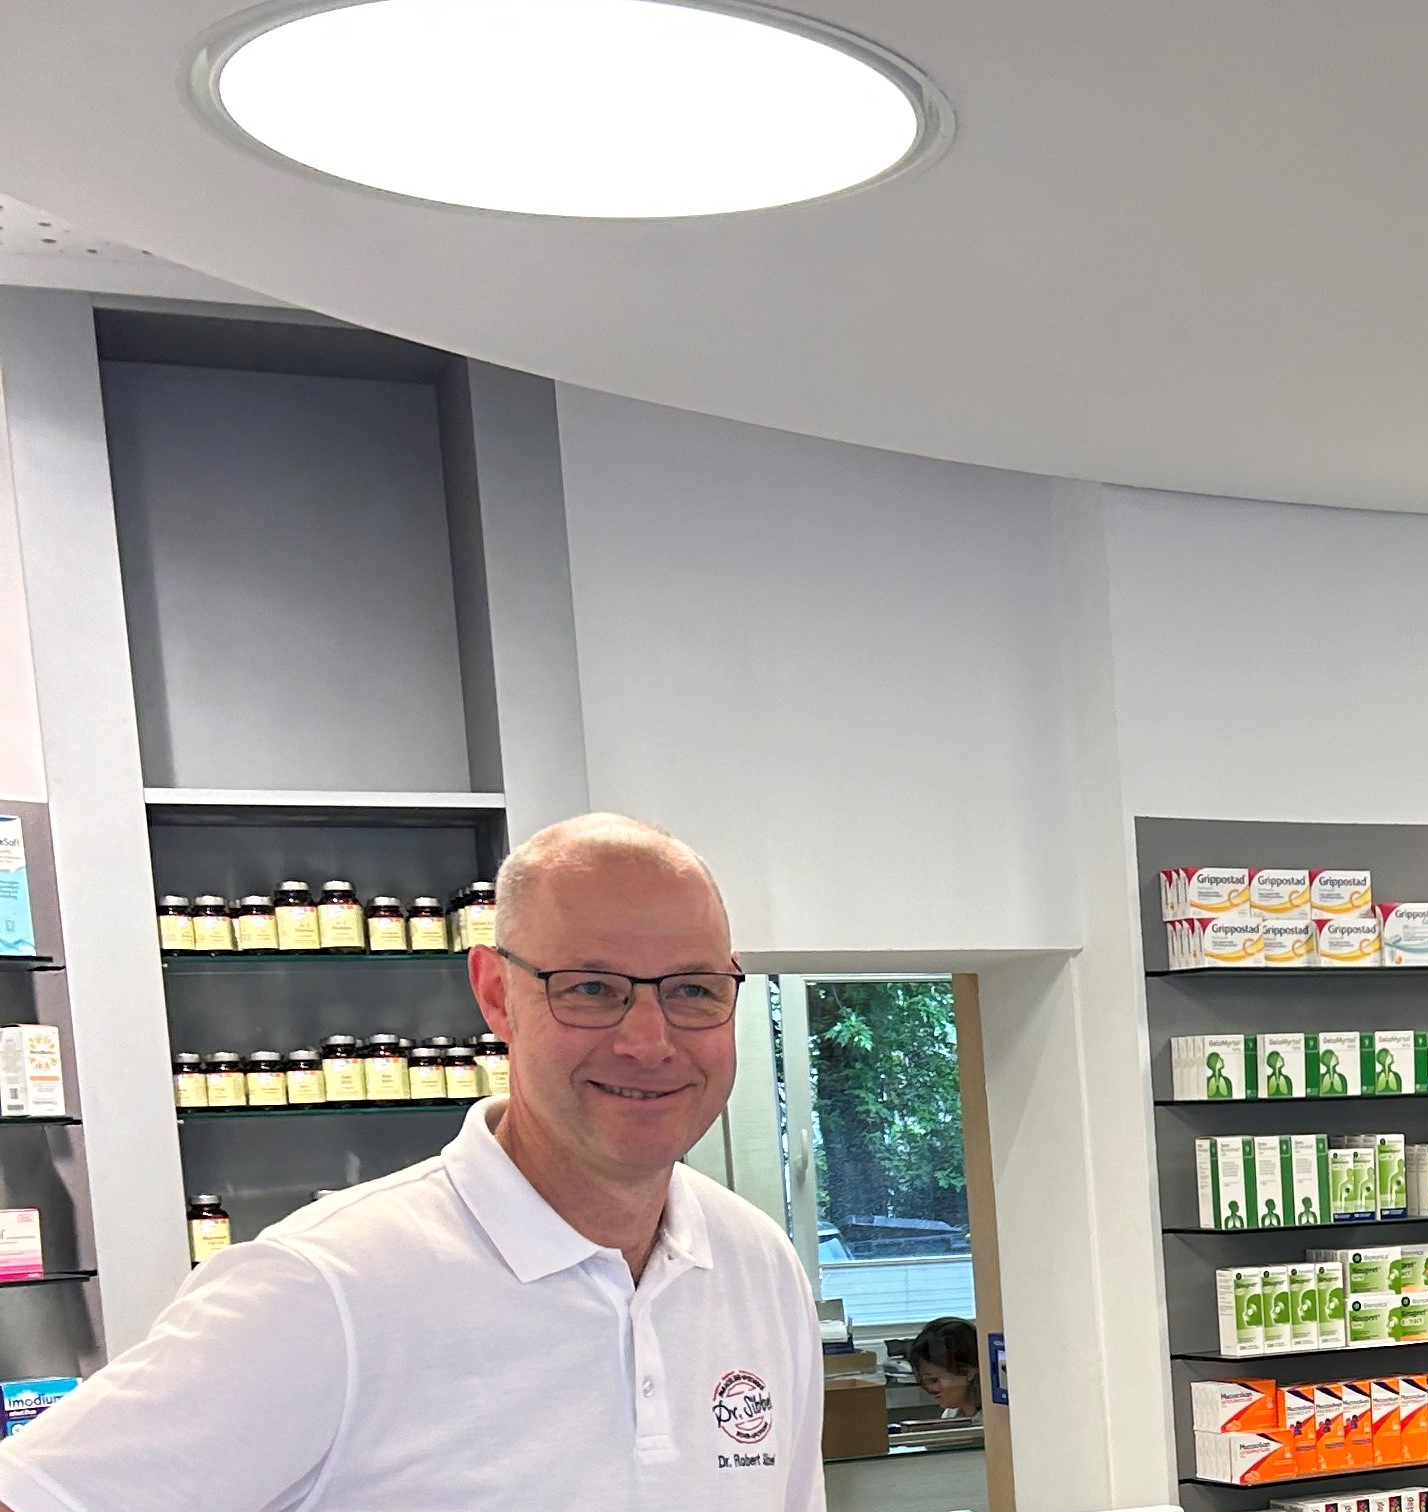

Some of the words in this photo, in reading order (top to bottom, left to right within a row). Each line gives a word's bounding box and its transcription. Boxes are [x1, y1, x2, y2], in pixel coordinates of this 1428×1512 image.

[1197, 874, 1245, 886] Grippostad
[1258, 875, 1306, 886] Grippostad
[1319, 876, 1367, 887] Grippostad
[1212, 923, 1259, 935] Grippostad
[1328, 924, 1376, 935] Grippostad
[718, 1455, 732, 1468] Dr.
[734, 1454, 761, 1467] Robert
